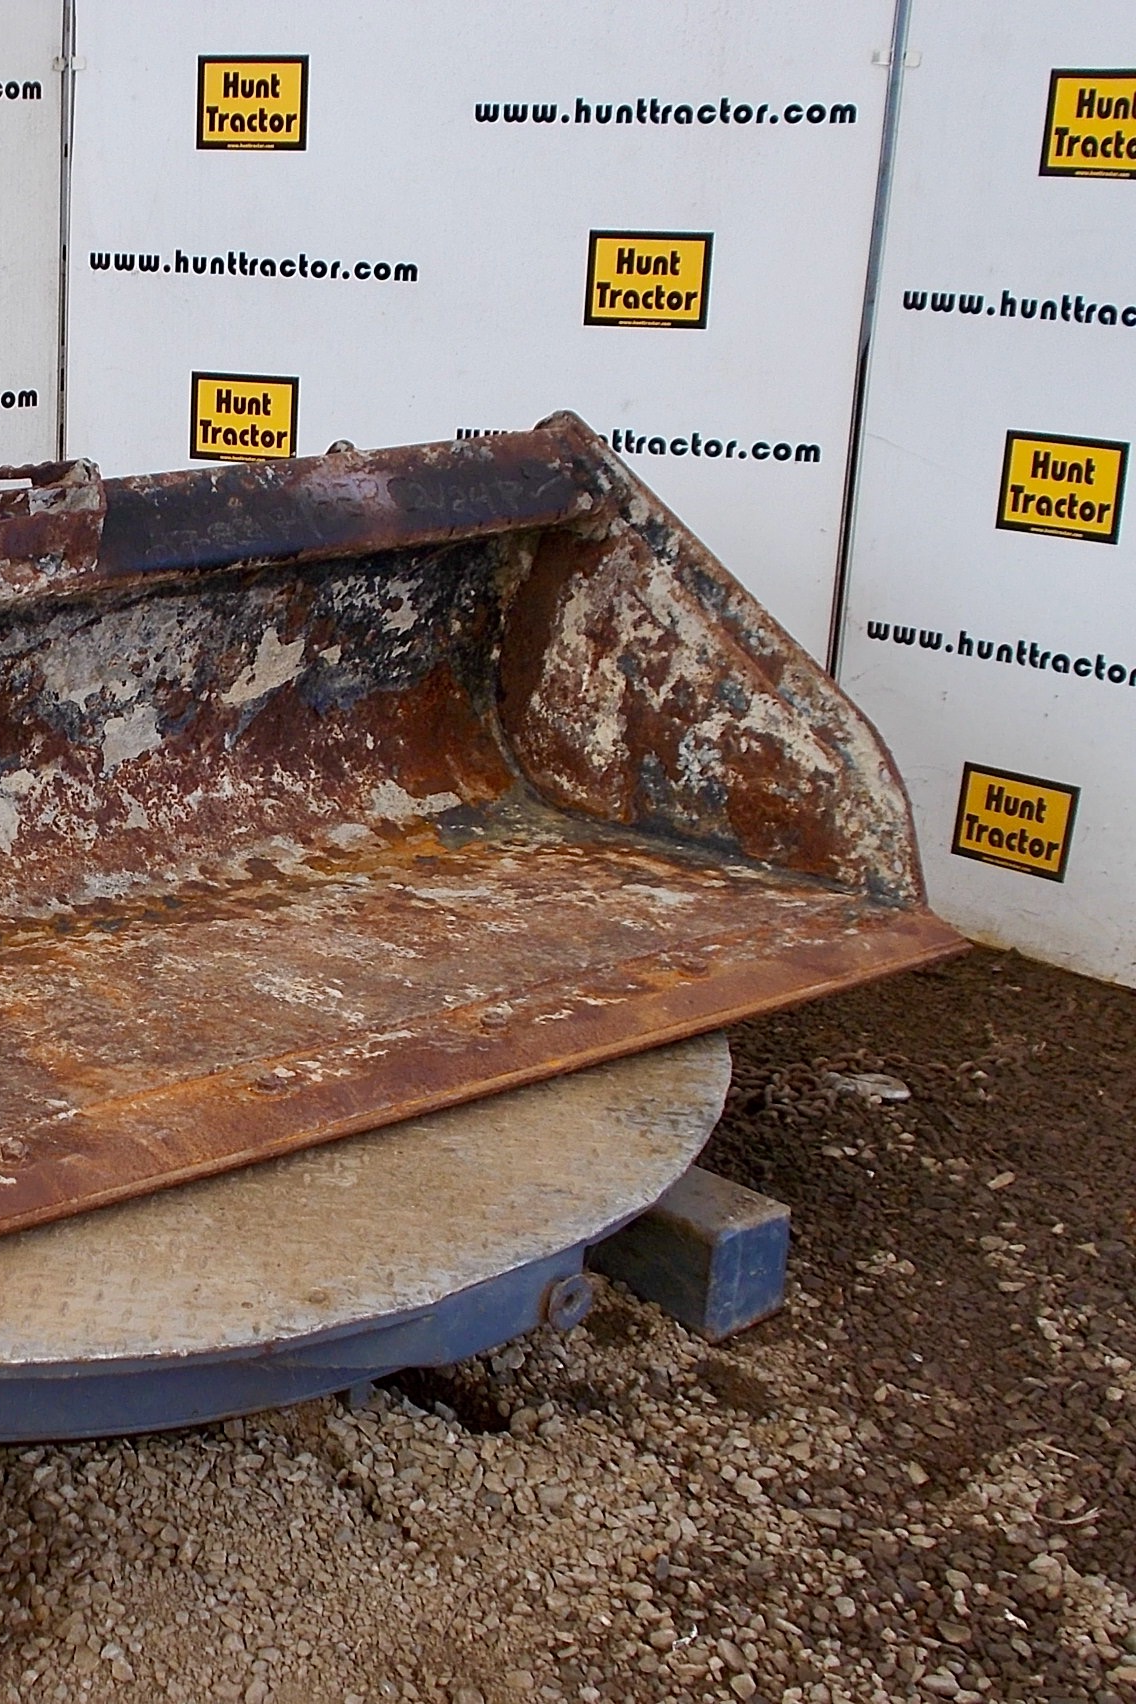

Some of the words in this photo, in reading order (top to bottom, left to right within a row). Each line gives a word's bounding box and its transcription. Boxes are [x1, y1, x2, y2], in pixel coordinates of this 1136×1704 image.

[224, 72, 280, 98] Hunt
[206, 106, 297, 132] Tractor
[476, 98, 856, 124] www.hunttractor.com
[90, 250, 417, 281] www.hunttractor.com
[617, 248, 680, 275] Hunt
[597, 282, 697, 310] Tractor
[217, 389, 271, 415] Hunt
[200, 420, 287, 448] Tractor
[1031, 451, 1095, 484] Hunt
[1010, 485, 1111, 523] Tractor
[985, 784, 1047, 823] Hunt
[966, 813, 1060, 861] Tractor
